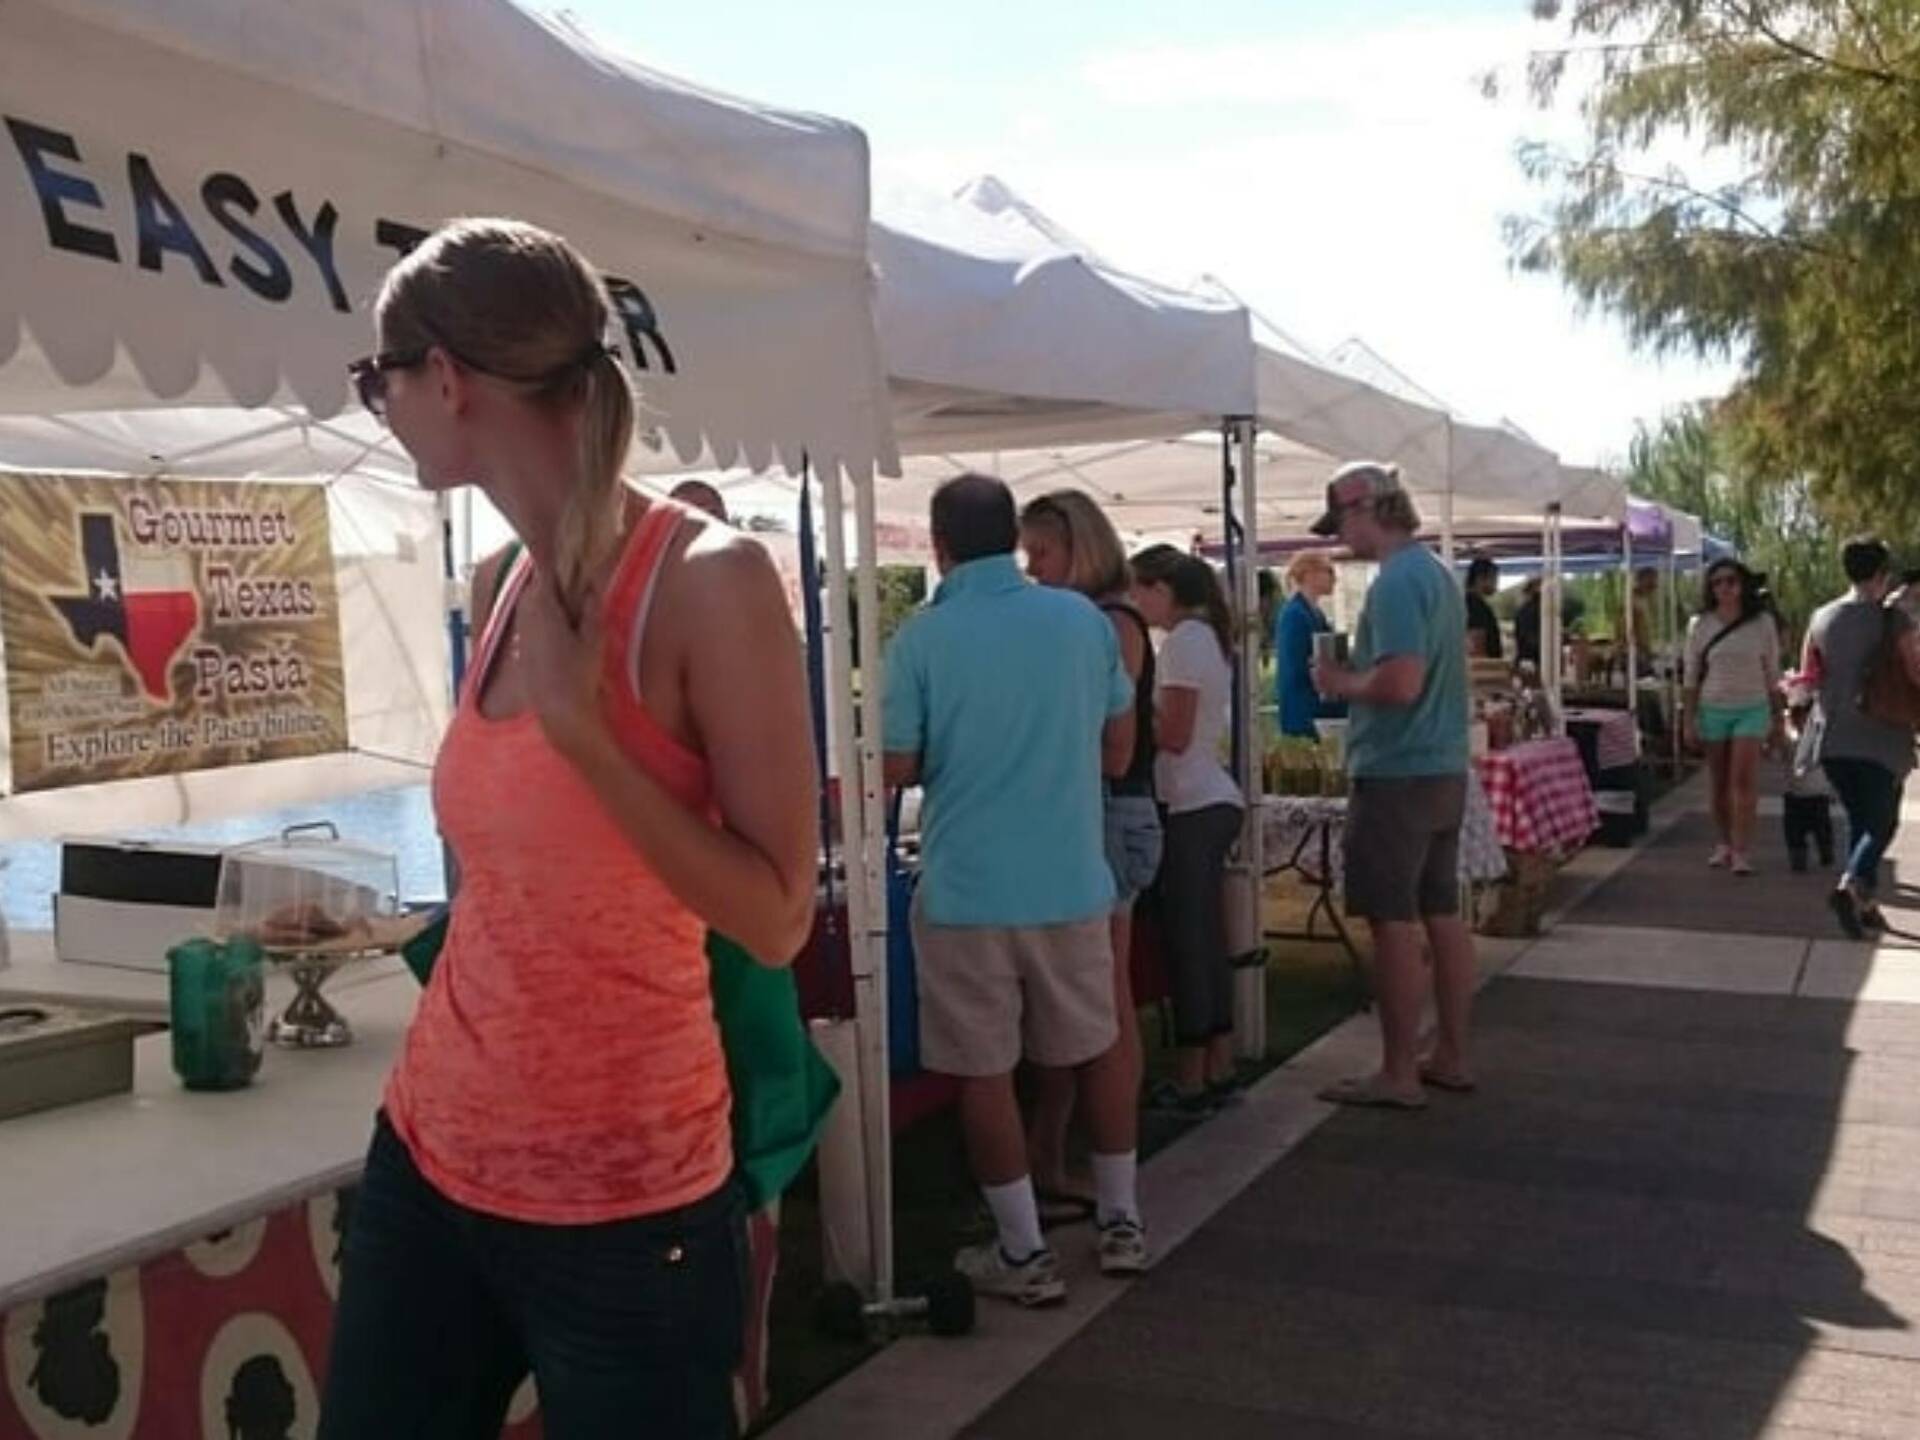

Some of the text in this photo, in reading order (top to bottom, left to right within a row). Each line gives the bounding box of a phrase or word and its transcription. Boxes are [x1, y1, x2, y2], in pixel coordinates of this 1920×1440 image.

[4, 115, 351, 313] EASY
[129, 499, 296, 546] Gourmet
[208, 567, 315, 619] Texas
[194, 650, 307, 698] Pasta
[47, 727, 150, 764] Explore
[160, 720, 194, 748] the
